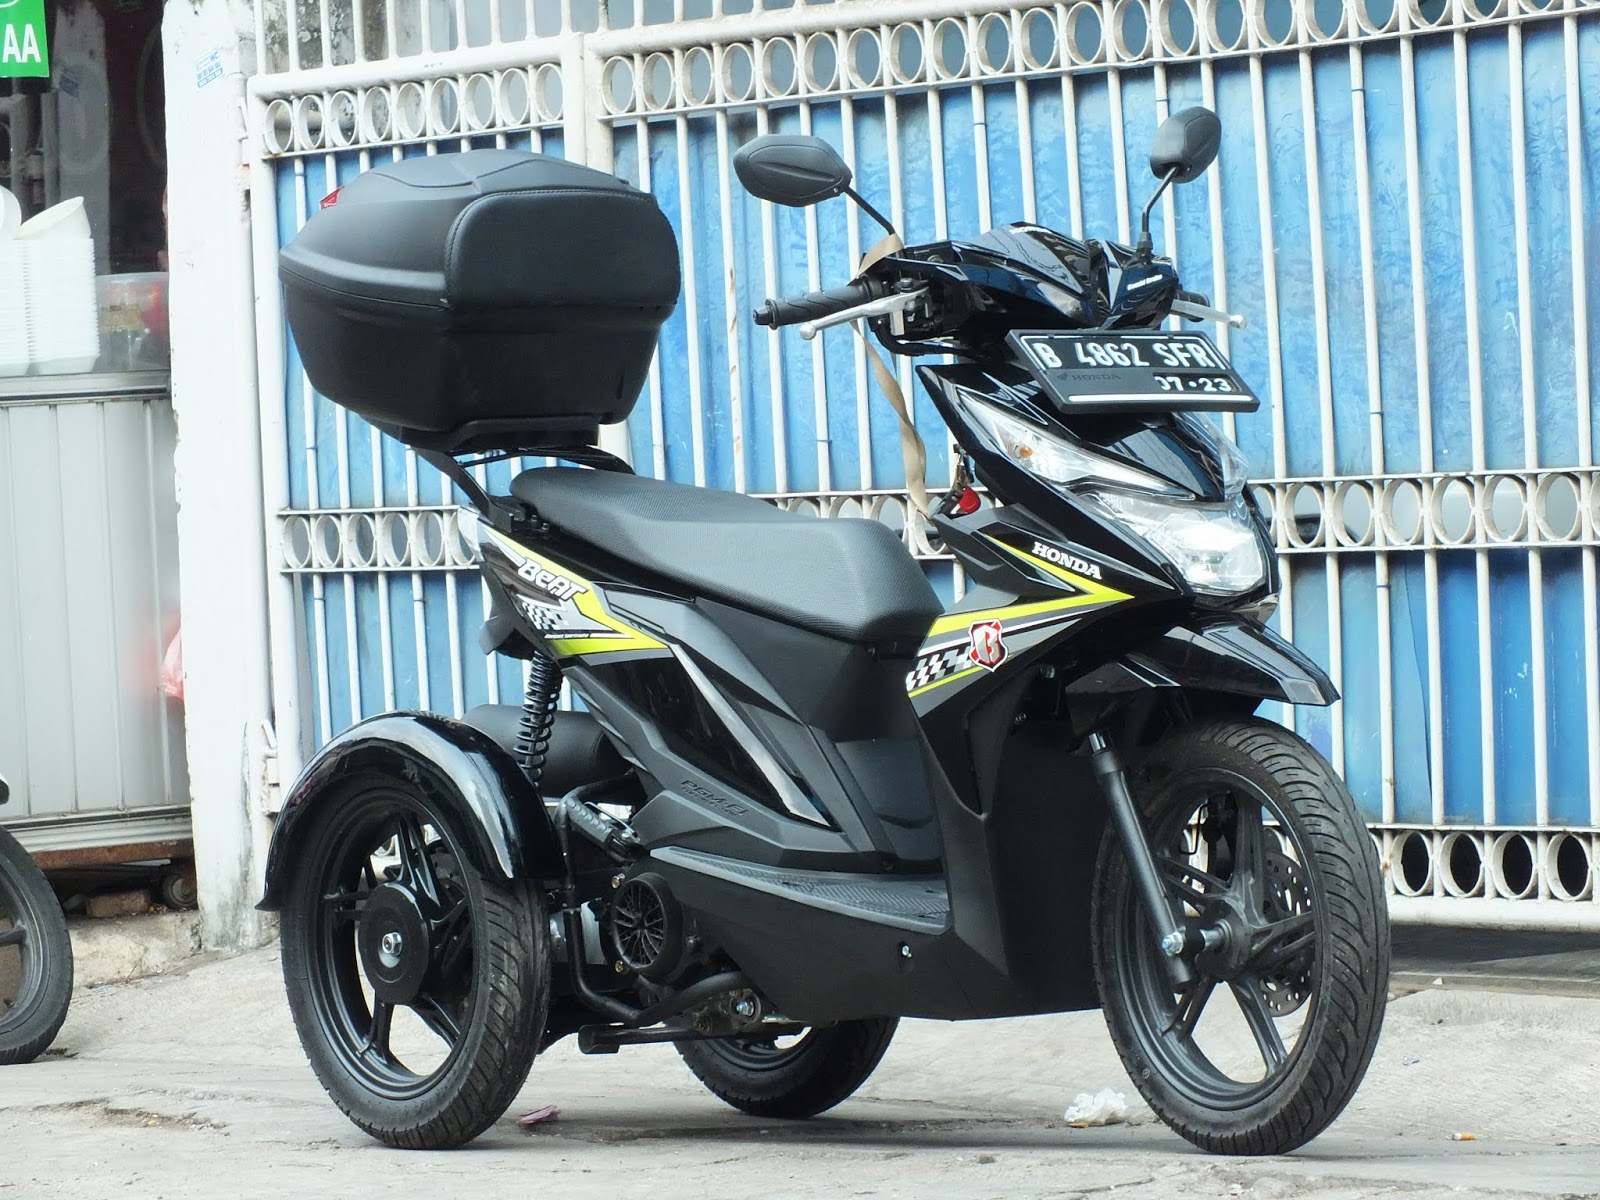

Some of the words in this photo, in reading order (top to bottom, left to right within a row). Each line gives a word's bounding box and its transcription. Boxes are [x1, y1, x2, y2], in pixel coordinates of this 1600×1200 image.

[2, 23, 41, 63] AA
[1032, 342, 1063, 368] B
[1073, 342, 1150, 367] 4862
[1152, 342, 1216, 368] SFR
[1031, 541, 1102, 580] HONDA
